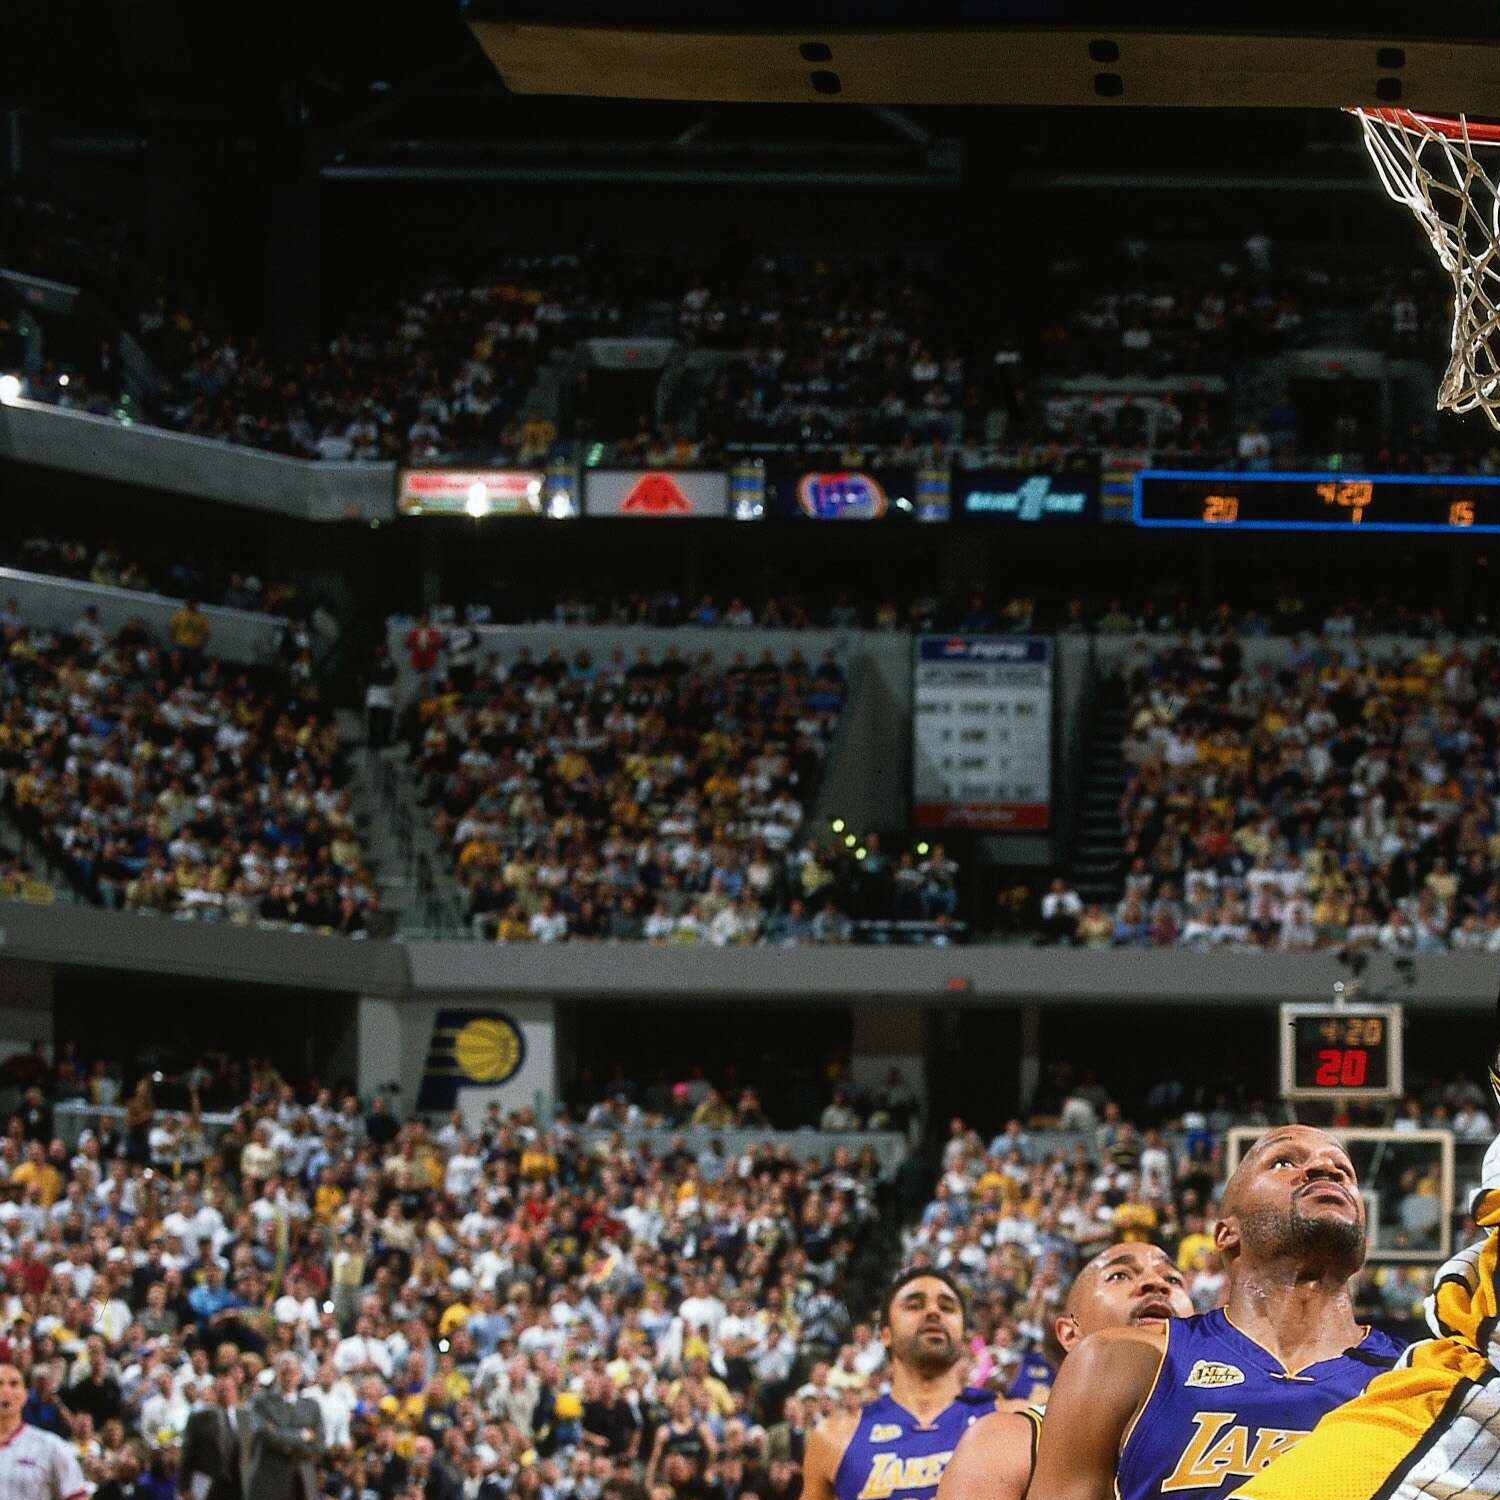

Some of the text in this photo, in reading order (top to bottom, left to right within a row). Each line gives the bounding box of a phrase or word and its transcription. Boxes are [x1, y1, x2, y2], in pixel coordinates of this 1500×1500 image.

[1202, 495, 1240, 523] 20
[1316, 1049, 1368, 1087] 20
[1160, 1411, 1315, 1493] LAK
